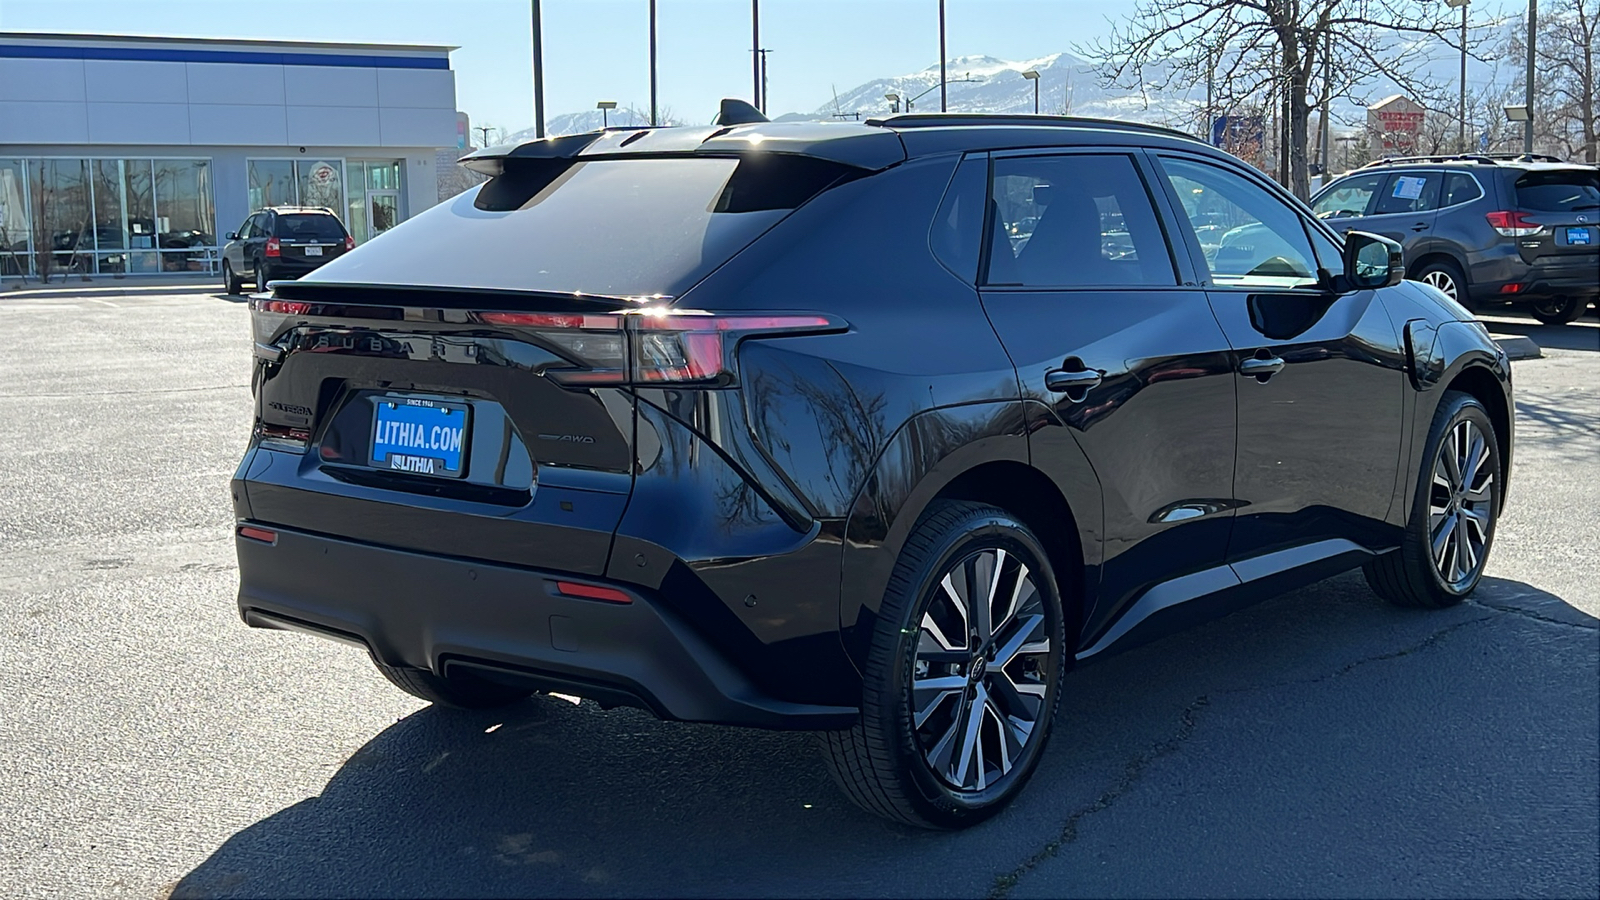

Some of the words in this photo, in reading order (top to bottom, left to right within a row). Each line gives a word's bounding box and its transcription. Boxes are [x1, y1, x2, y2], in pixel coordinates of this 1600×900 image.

[318, 335, 478, 358] SUBARU
[375, 419, 463, 453] LITHIA.COM
[559, 434, 595, 444] AWD
[401, 455, 434, 474] LITHIA
